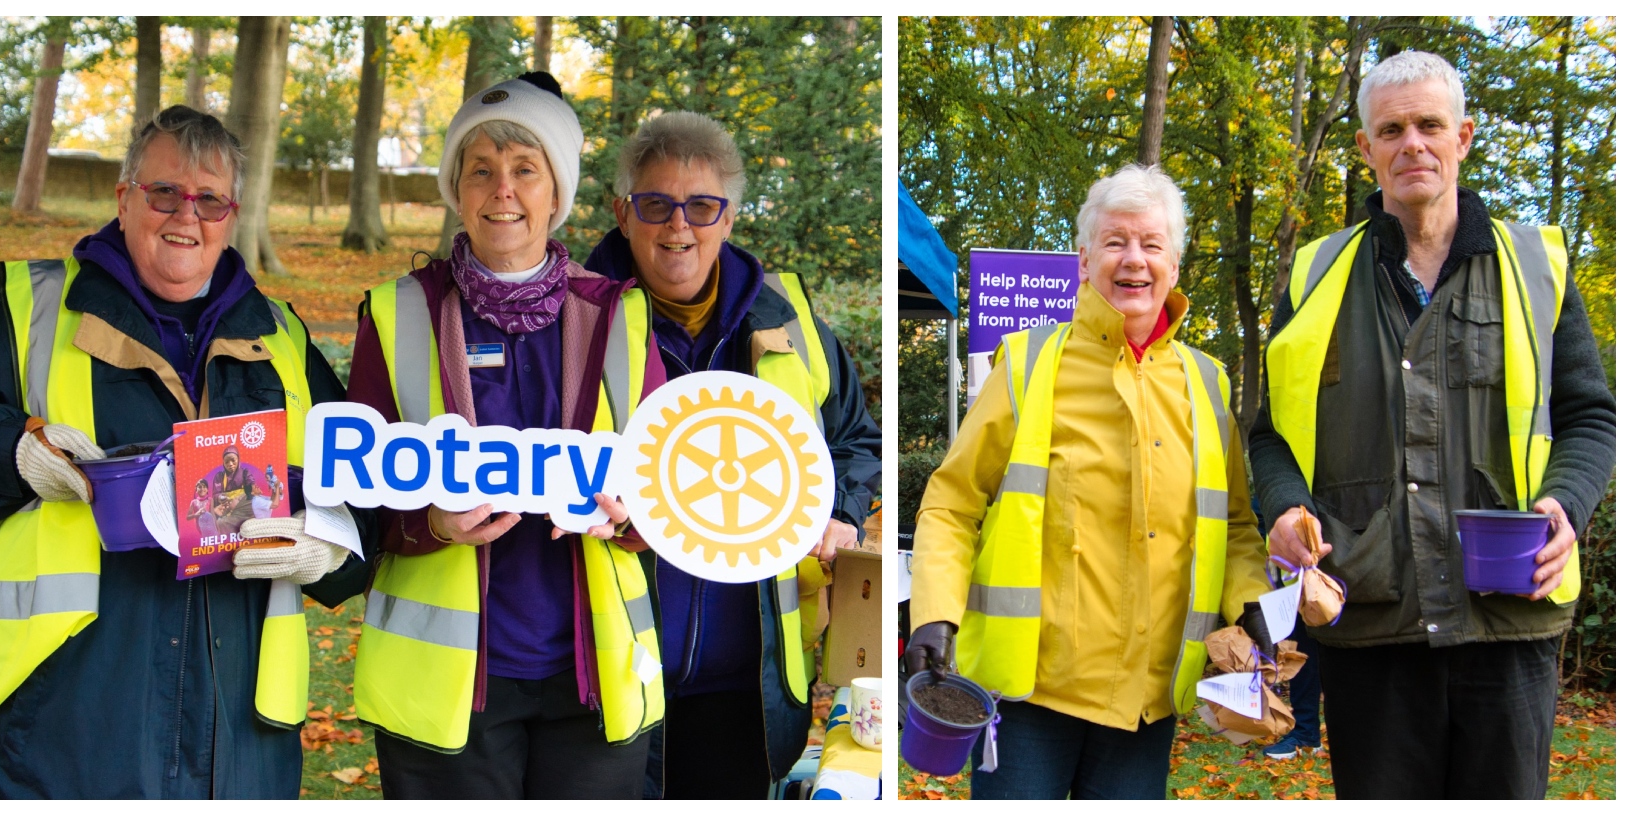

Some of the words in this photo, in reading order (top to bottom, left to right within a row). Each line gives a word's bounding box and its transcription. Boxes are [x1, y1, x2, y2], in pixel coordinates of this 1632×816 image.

[980, 272, 1016, 290] Help
[1021, 274, 1071, 293] Rotary
[978, 292, 1010, 307] free
[1014, 293, 1039, 308] the
[1044, 295, 1078, 310] worl
[978, 312, 1014, 327] from
[1019, 314, 1058, 331] polio
[195, 433, 238, 448] Rotary
[320, 416, 614, 516] Rotary
[200, 534, 227, 547] HELP
[192, 546, 215, 557] END
